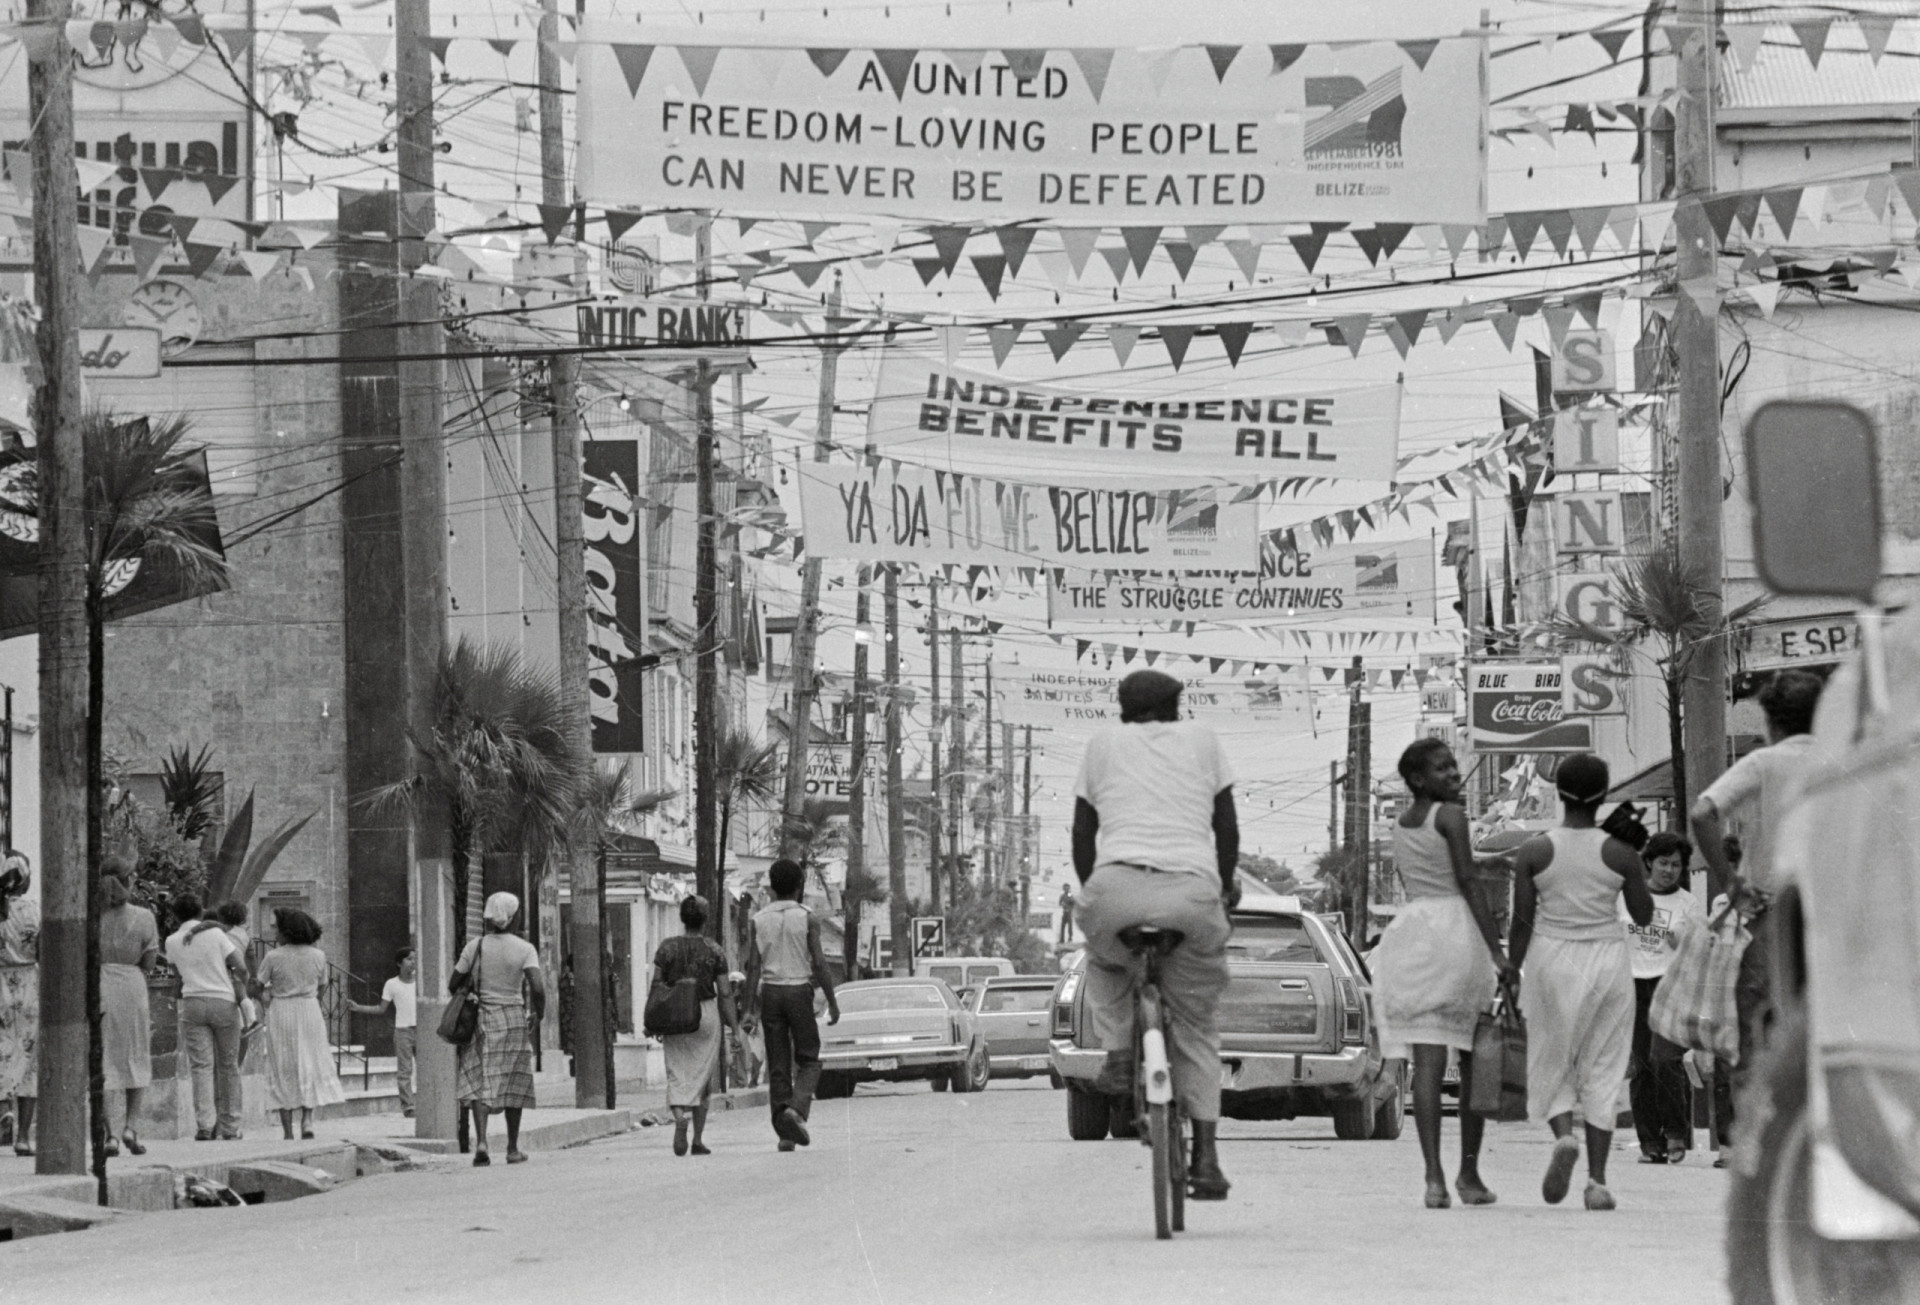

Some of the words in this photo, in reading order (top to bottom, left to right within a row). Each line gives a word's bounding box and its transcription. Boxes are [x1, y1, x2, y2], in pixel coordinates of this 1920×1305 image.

[857, 60, 884, 93] A
[913, 62, 1069, 99] UNITED
[661, 101, 1047, 152] FREEDOM-LOVING
[1090, 122, 1260, 155] PEOPLE
[661, 155, 746, 191] CAN
[779, 162, 916, 200] NEVER
[952, 169, 1004, 202] BE
[1039, 172, 1266, 206] DEFEATED
[1315, 183, 1365, 196] BELIZE
[657, 307, 732, 347] BANK
[926, 372, 1336, 427] INDEPENDENCE
[917, 402, 1183, 453] BENEFITS
[1234, 427, 1338, 462] ALL
[838, 480, 877, 544] YA
[891, 483, 931, 547] DA
[1056, 489, 1150, 554] BELIZE
[1069, 586, 1107, 609] THE
[1120, 586, 1225, 612] STRUGGLE
[1235, 586, 1345, 610] CONTINUES
[1031, 672, 1120, 687] INDEPENDE
[1478, 673, 1509, 689] BLUE
[1535, 673, 1561, 688] BIRD
[1064, 707, 1107, 720] FROM
[1491, 698, 1564, 723] Coca-Cola
